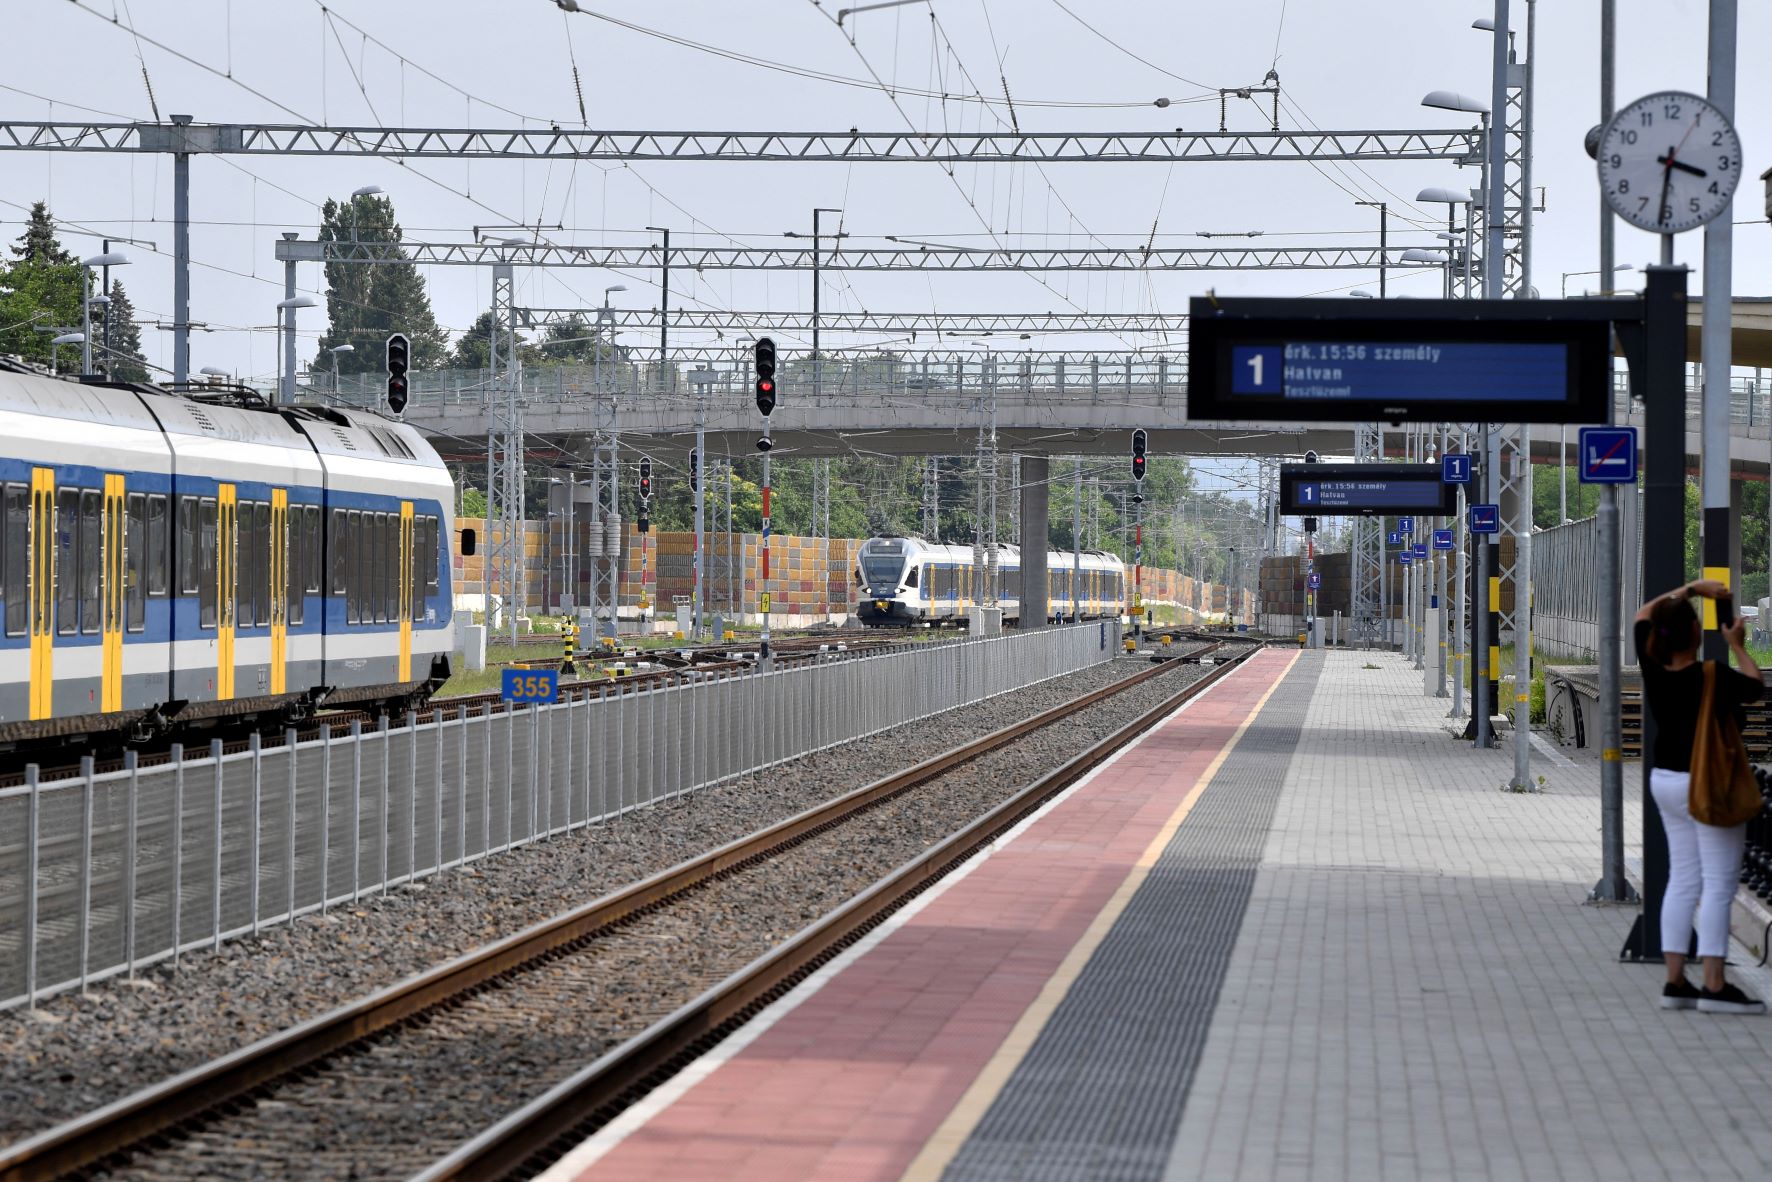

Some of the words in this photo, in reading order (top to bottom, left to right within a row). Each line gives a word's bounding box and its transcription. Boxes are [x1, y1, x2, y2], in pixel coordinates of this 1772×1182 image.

[1641, 112, 1652, 127] 11
[1664, 105, 1681, 120] 12
[1695, 113, 1701, 127] 1
[1620, 130, 1637, 145] 10
[1712, 131, 1723, 146] 2
[1611, 154, 1622, 169] 9
[1718, 156, 1729, 170] 3
[1618, 179, 1629, 194] 8
[1708, 181, 1719, 195] 4
[1638, 197, 1649, 212] 7
[1689, 198, 1700, 213] 5
[1662, 205, 1673, 220] 6
[1374, 345, 1440, 363] személy
[1247, 354, 1263, 385] 1
[1284, 366, 1342, 380] Hatvan
[1452, 459, 1460, 474] 1
[1304, 487, 1312, 500] 1
[1403, 520, 1408, 529] 1
[512, 677, 551, 697] 355
